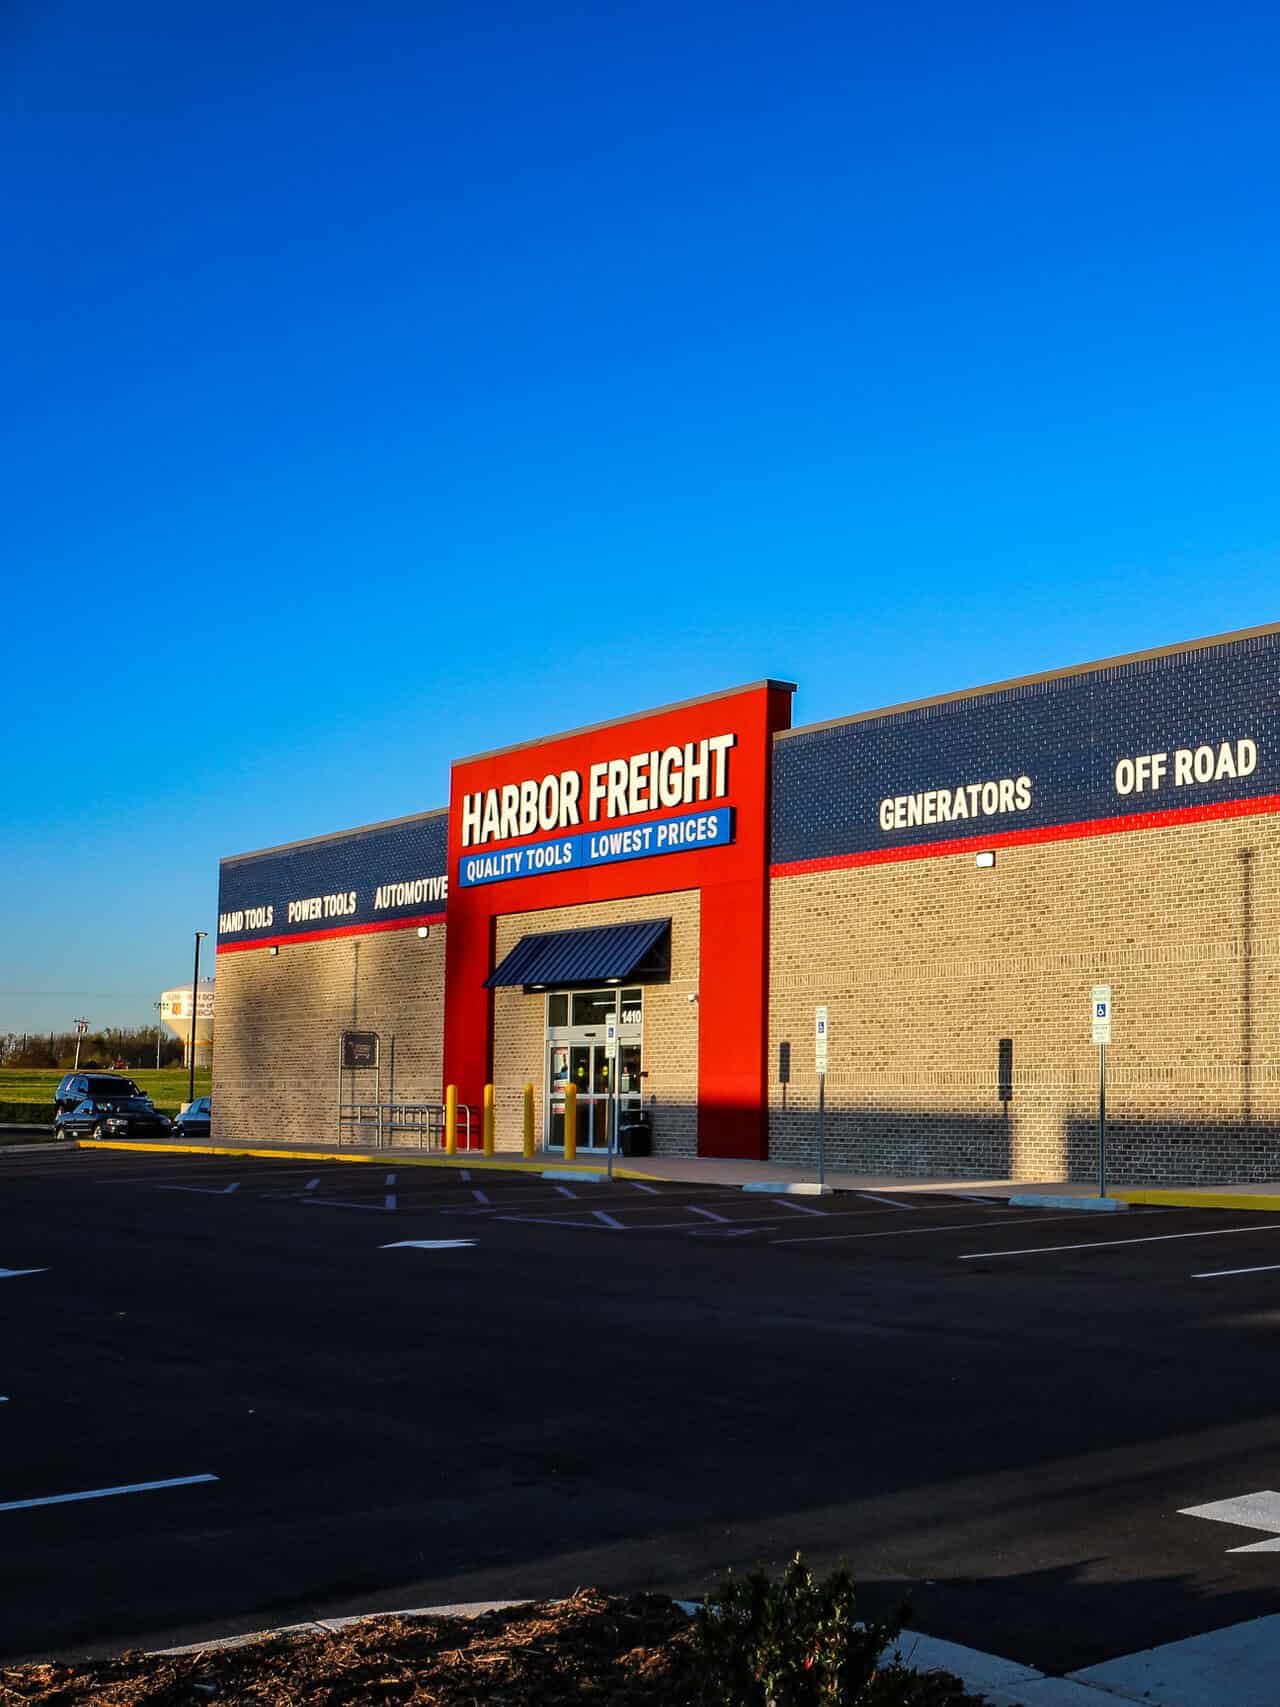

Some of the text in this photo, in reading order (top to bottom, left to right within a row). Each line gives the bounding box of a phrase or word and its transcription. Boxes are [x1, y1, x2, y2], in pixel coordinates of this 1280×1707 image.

[1114, 739, 1258, 796] OFF ROAD
[461, 733, 735, 847] HARBOR FREIGHT
[879, 775, 1032, 831] GENERATORS
[590, 815, 718, 859] LOWEST PRICES
[466, 842, 573, 882] QUALITY TOOLS
[288, 891, 357, 924] POWER TOOLS
[374, 875, 449, 910] AUTOMOTIVE
[219, 906, 273, 934] HAND TOOLS
[622, 1010, 641, 1023] 1410
